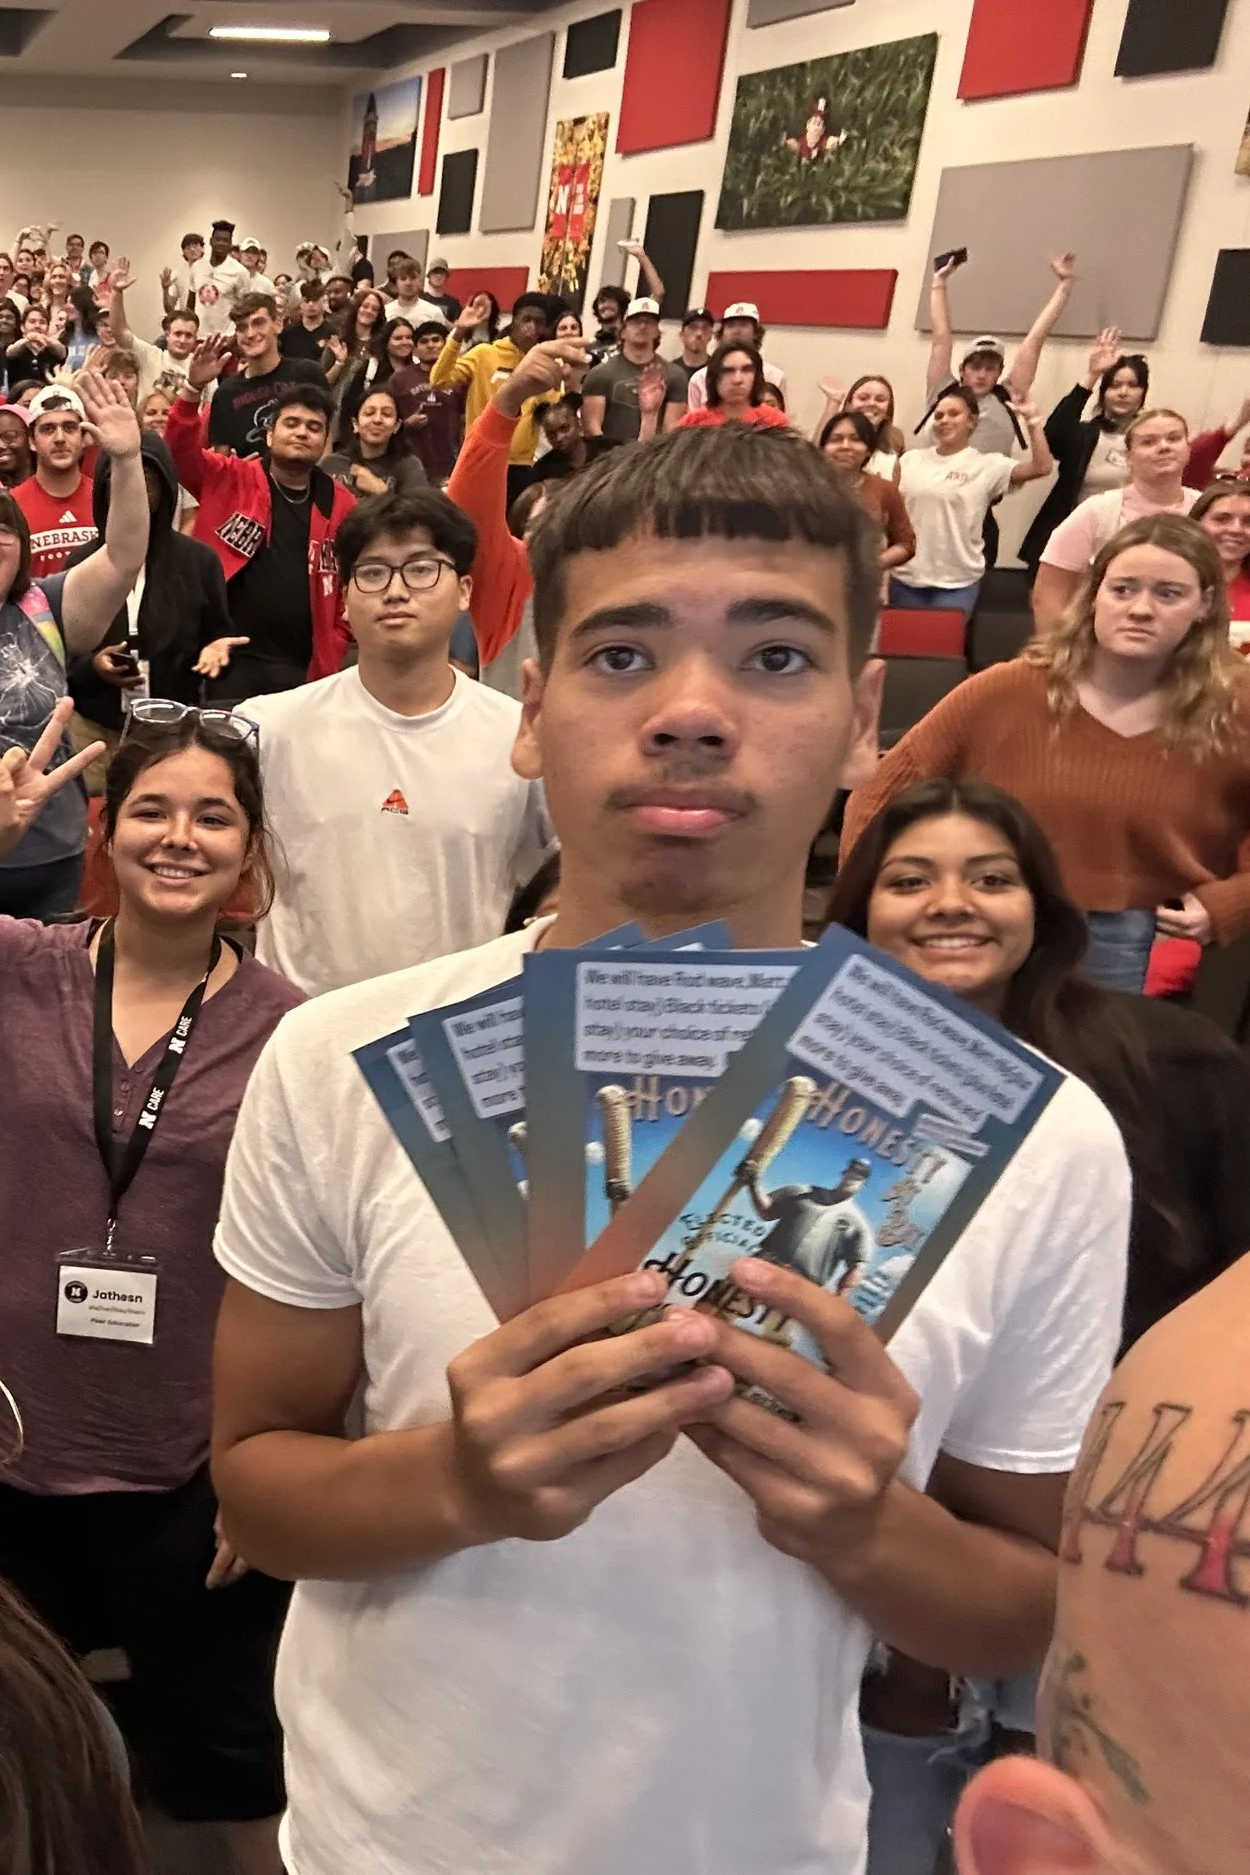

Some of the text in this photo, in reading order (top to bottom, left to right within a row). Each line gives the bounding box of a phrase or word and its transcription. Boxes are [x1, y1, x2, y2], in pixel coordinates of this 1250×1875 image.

[168, 1016, 193, 1054] N CARE
[138, 1087, 165, 1130] N CARE
